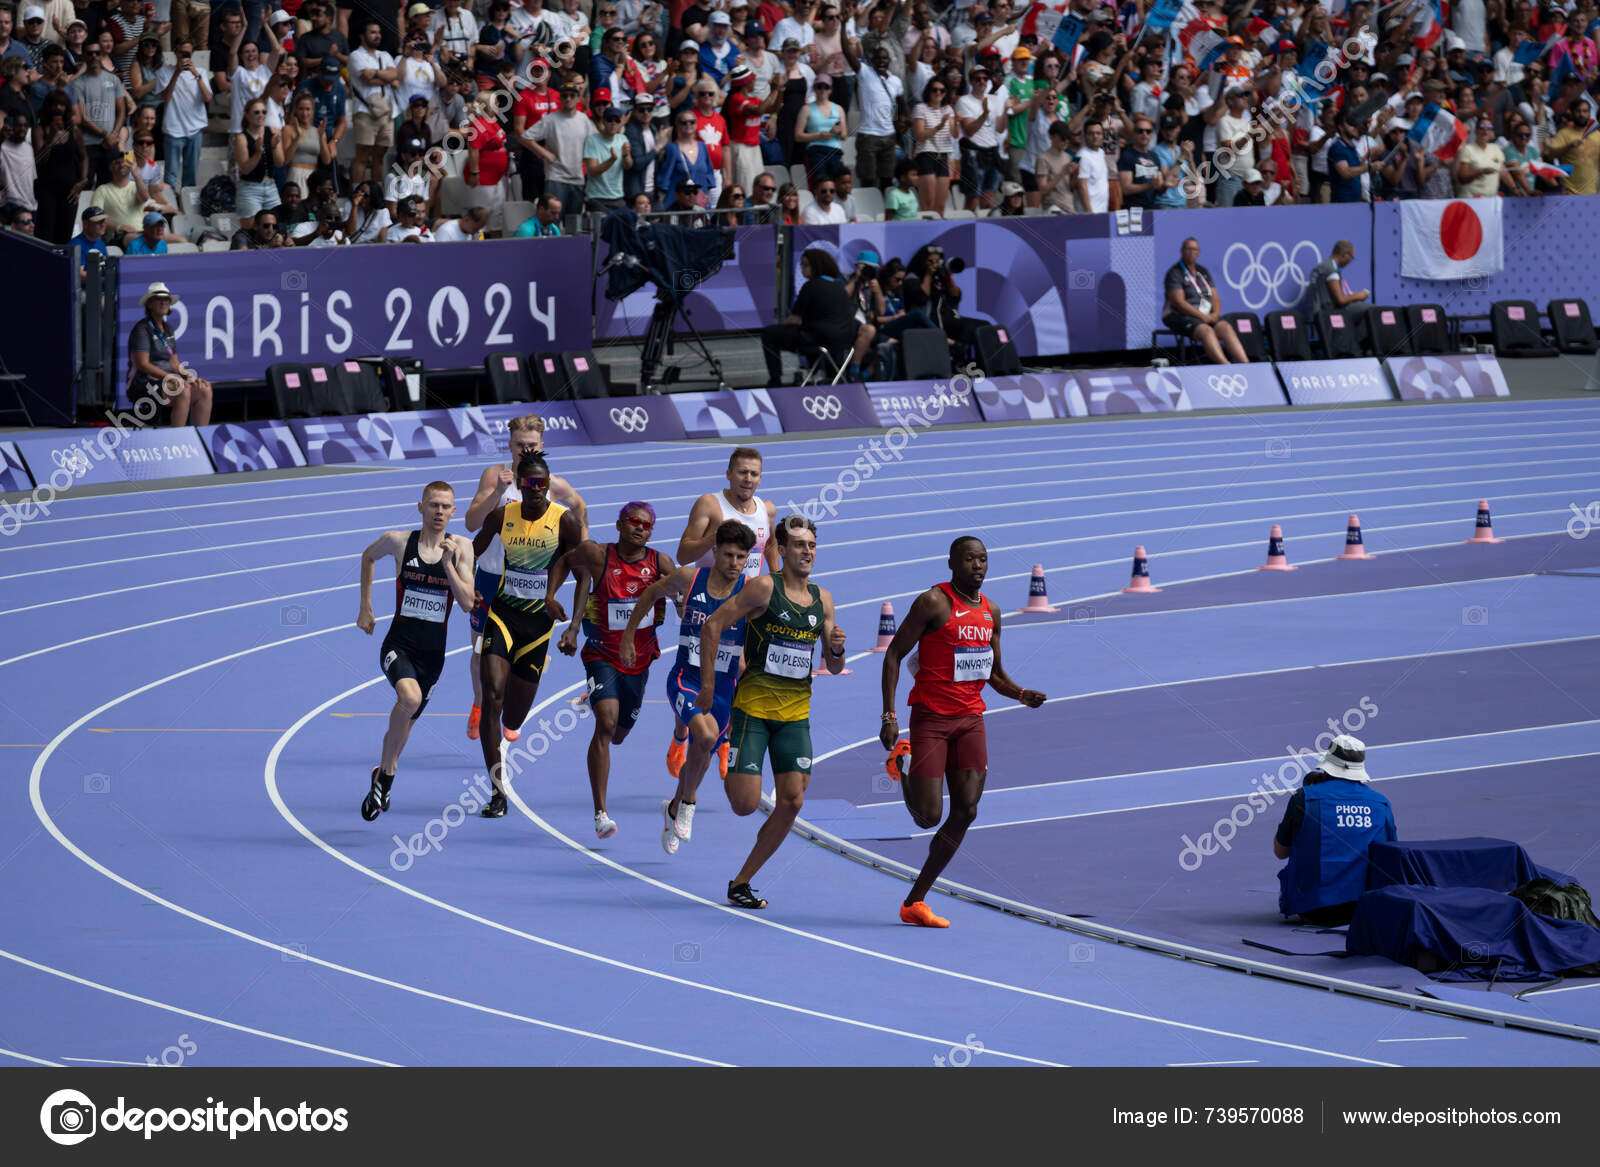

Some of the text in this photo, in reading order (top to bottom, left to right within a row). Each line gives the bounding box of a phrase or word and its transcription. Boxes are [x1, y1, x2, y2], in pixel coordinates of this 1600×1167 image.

[384, 281, 556, 350] 2024
[1337, 373, 1380, 387] 2024
[508, 537, 547, 549] JAMAICA
[404, 596, 446, 612] PATTISON
[768, 652, 781, 664] du
[1335, 805, 1371, 815] PHOTO
[1336, 815, 1372, 828] 1038
